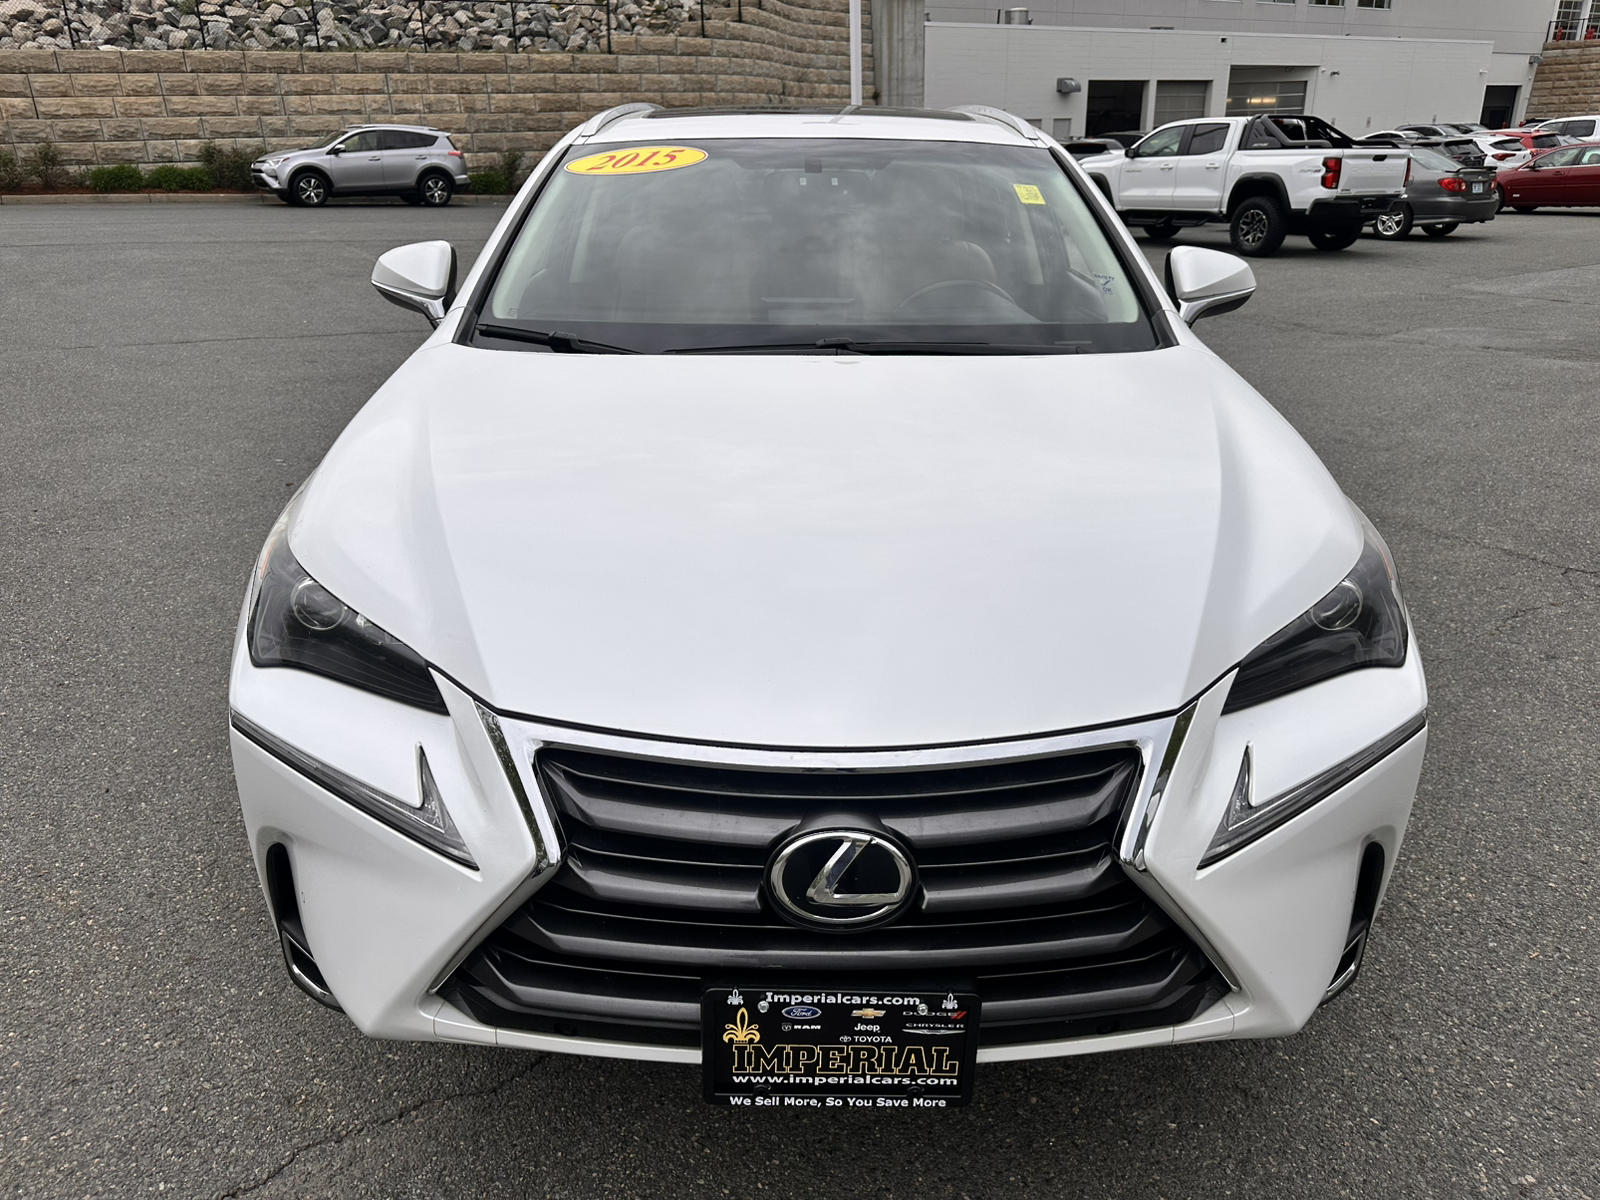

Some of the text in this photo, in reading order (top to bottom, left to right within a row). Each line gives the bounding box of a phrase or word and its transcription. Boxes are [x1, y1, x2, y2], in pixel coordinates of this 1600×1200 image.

[586, 149, 686, 171] 2015
[765, 992, 920, 1006] Imperialcars.com
[790, 1008, 812, 1017] Ford
[854, 1023, 880, 1032] Jeep
[732, 1044, 959, 1076] IMPERIAL
[732, 1074, 958, 1086] www.imperialcars.com
[729, 1096, 947, 1108] We Sell More, So You Save More
